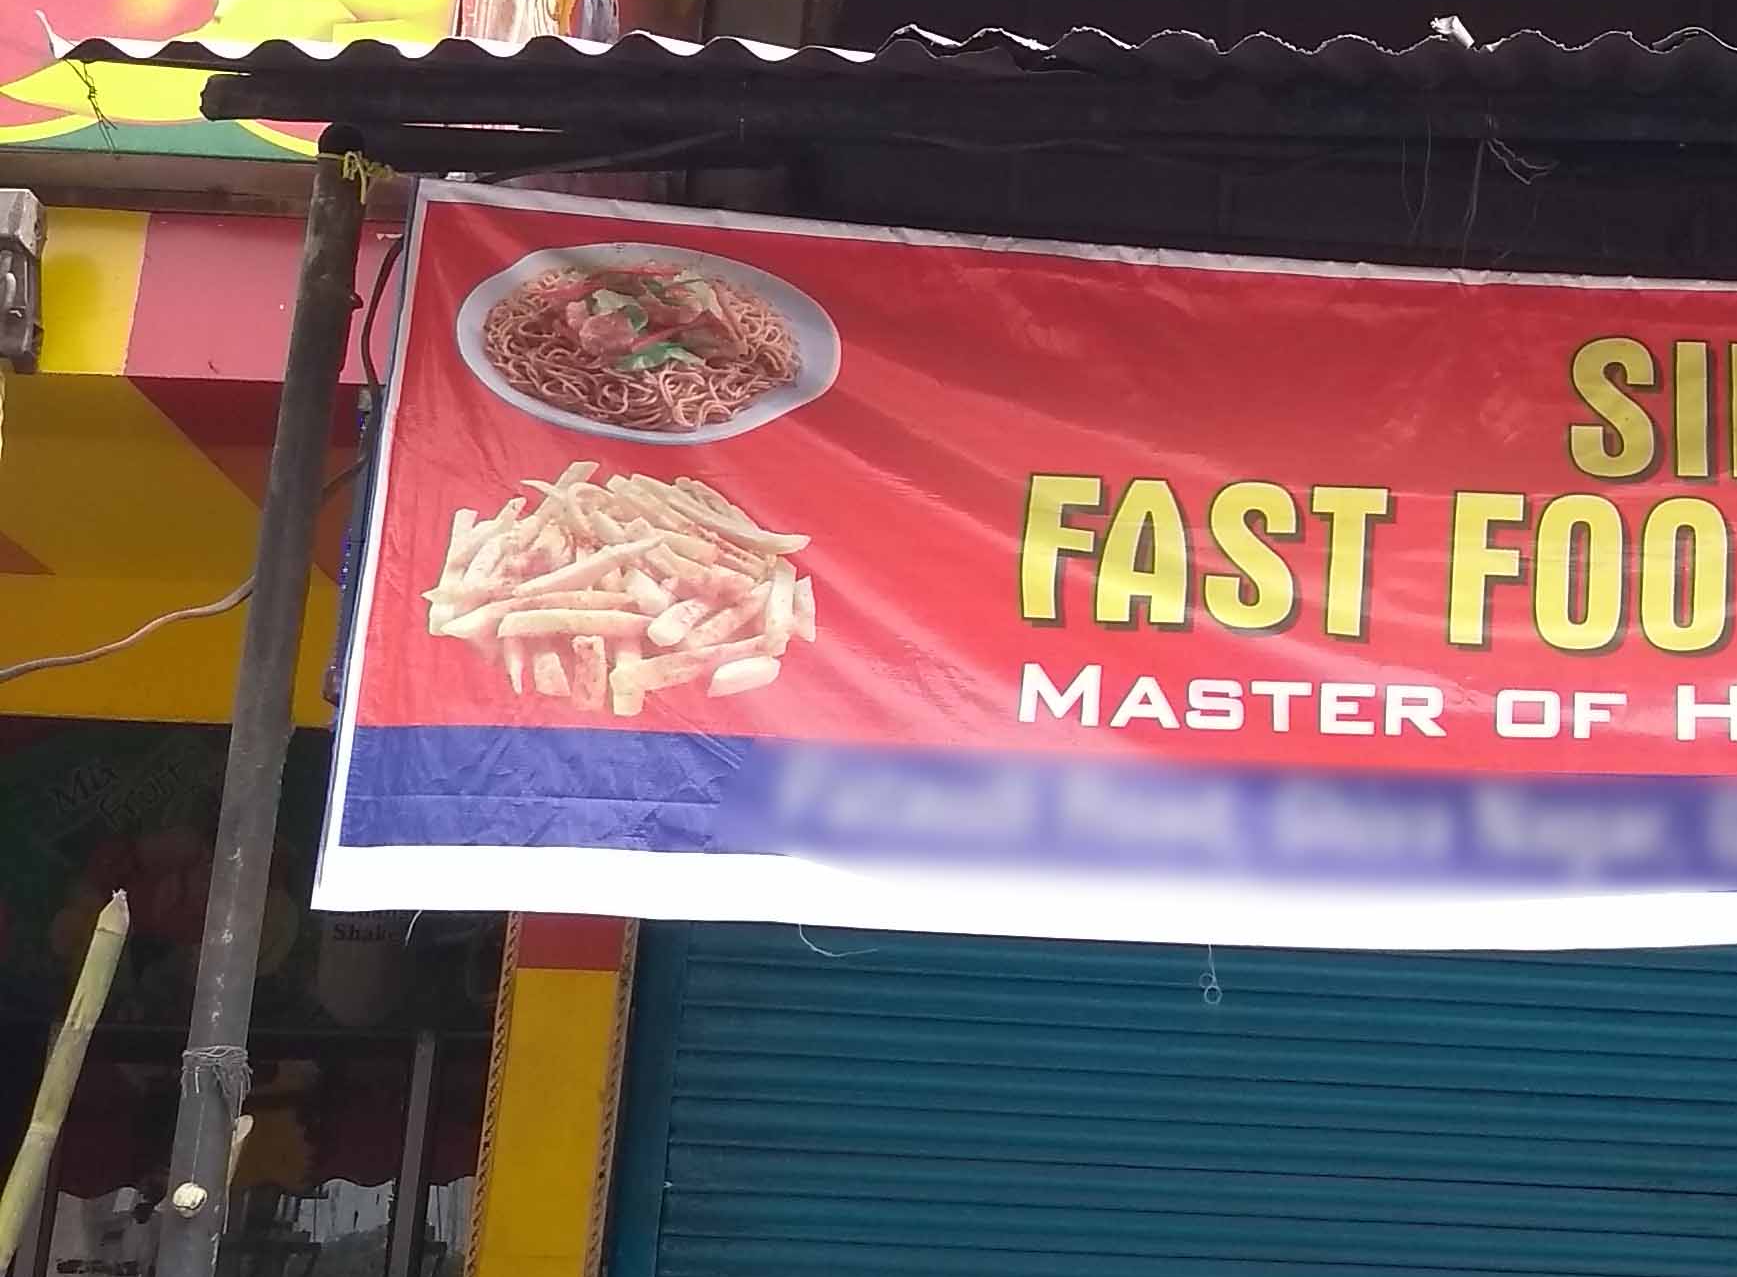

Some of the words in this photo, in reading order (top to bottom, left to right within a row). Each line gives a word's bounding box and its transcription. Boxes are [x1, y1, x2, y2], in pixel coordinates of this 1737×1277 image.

[1020, 474, 1394, 643] FAST
[1017, 662, 1447, 738] MASTER
[1495, 687, 1628, 741] OF
